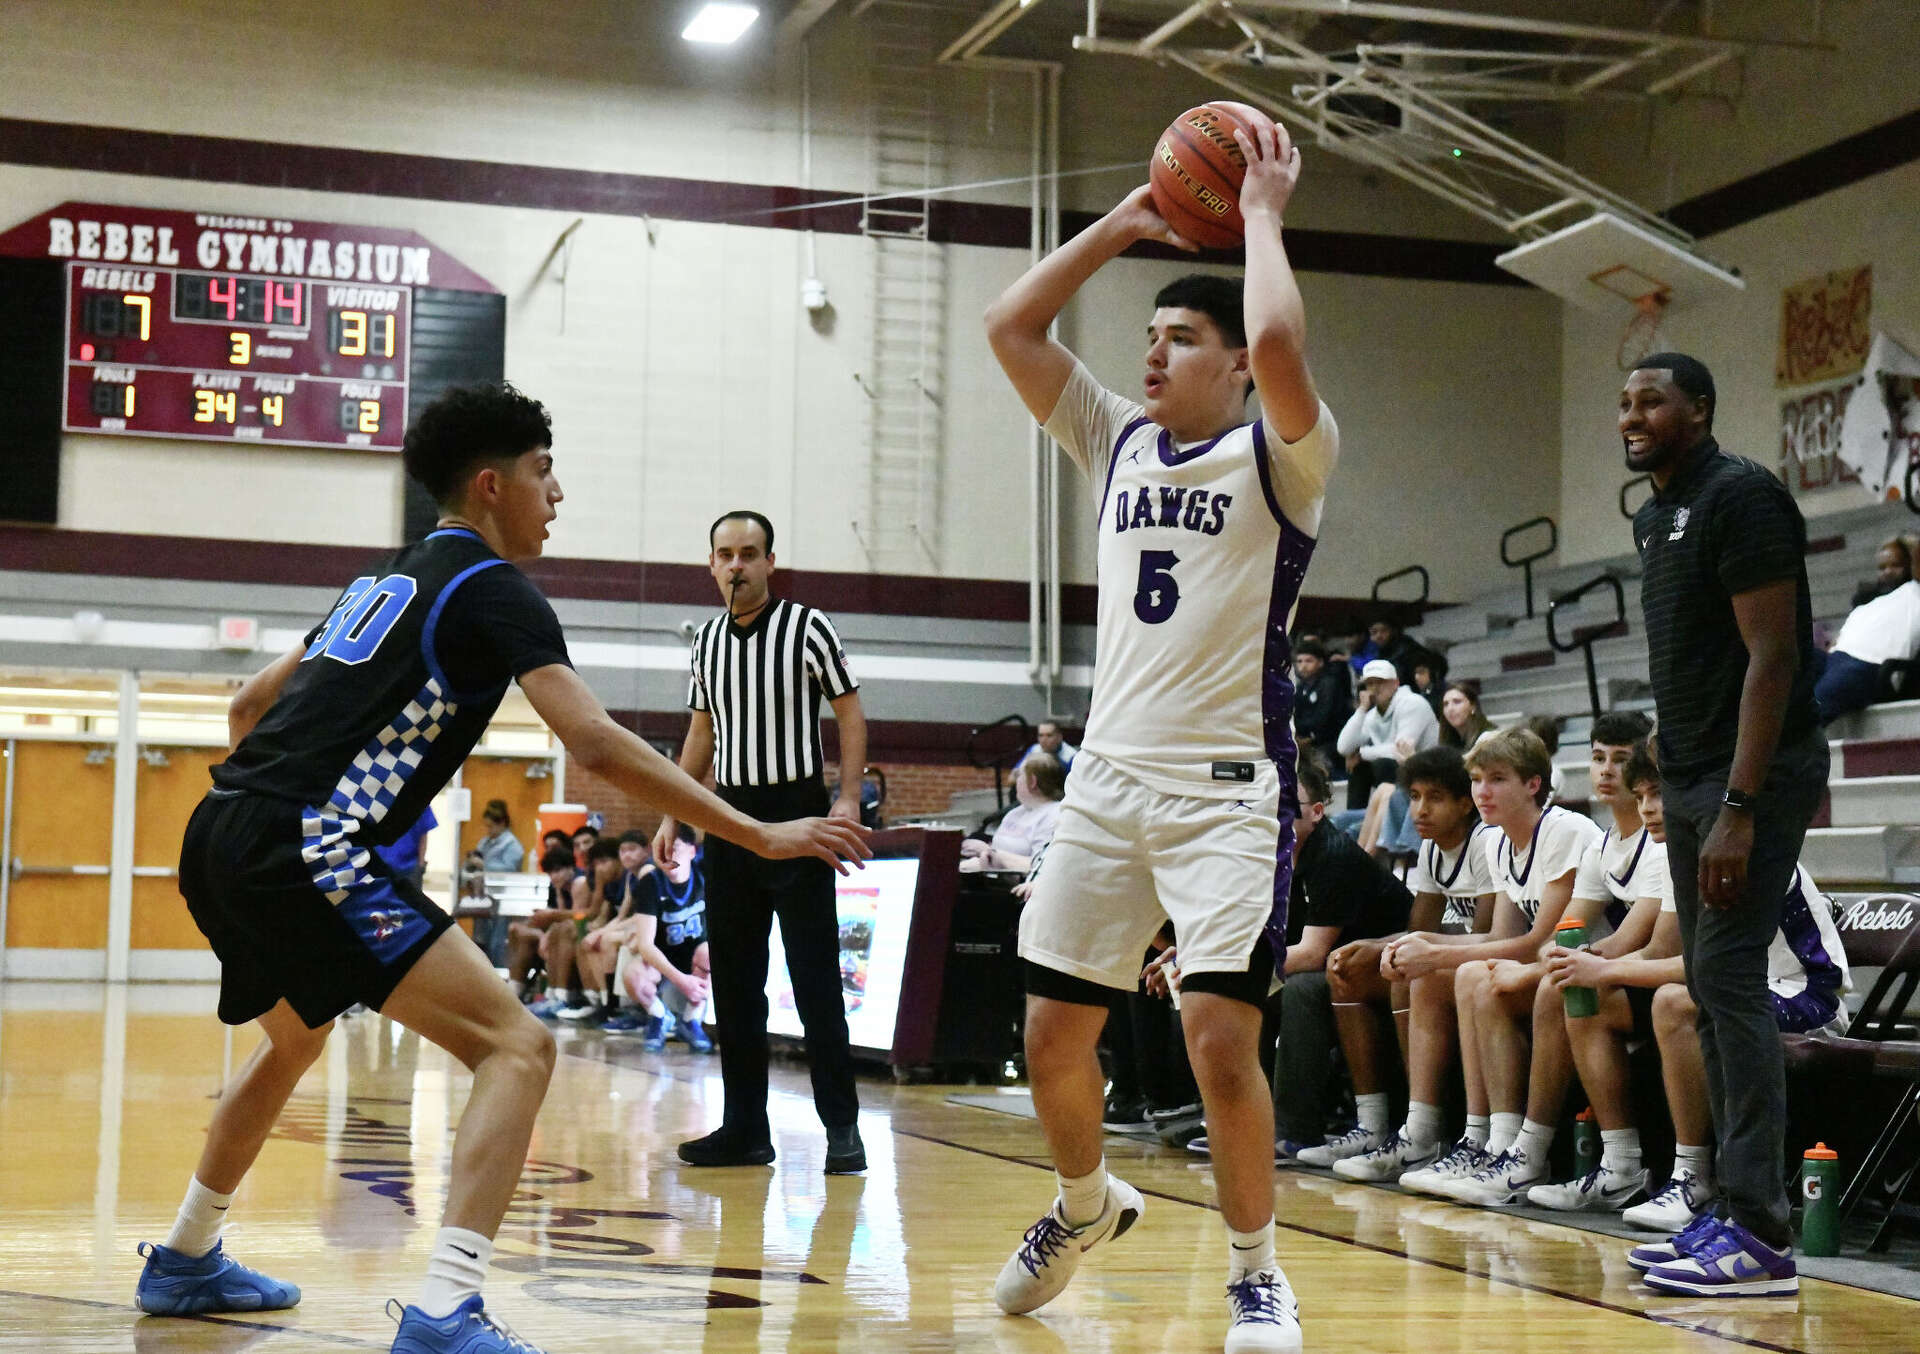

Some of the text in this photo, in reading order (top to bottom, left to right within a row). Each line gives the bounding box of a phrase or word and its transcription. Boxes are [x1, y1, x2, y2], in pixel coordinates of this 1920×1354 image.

[1197, 187, 1231, 215] PRO
[195, 214, 293, 234] WELCOME TO
[48, 218, 430, 285] REBEL GYMNASIUM
[82, 267, 156, 293] REBELS
[209, 277, 302, 327] 4:14
[327, 286, 400, 312] VISITOR
[123, 295, 151, 342] 7
[339, 310, 396, 359] 31
[228, 332, 252, 366] 3
[125, 384, 136, 418] 1
[194, 390, 235, 424] 34
[262, 394, 284, 428] 4
[359, 400, 381, 434] 2
[1116, 486, 1233, 535] DAWGS
[1134, 550, 1180, 624] 5
[300, 574, 417, 665] 30
[1841, 900, 1913, 930] Rebels
[1803, 1176, 1822, 1200] G
